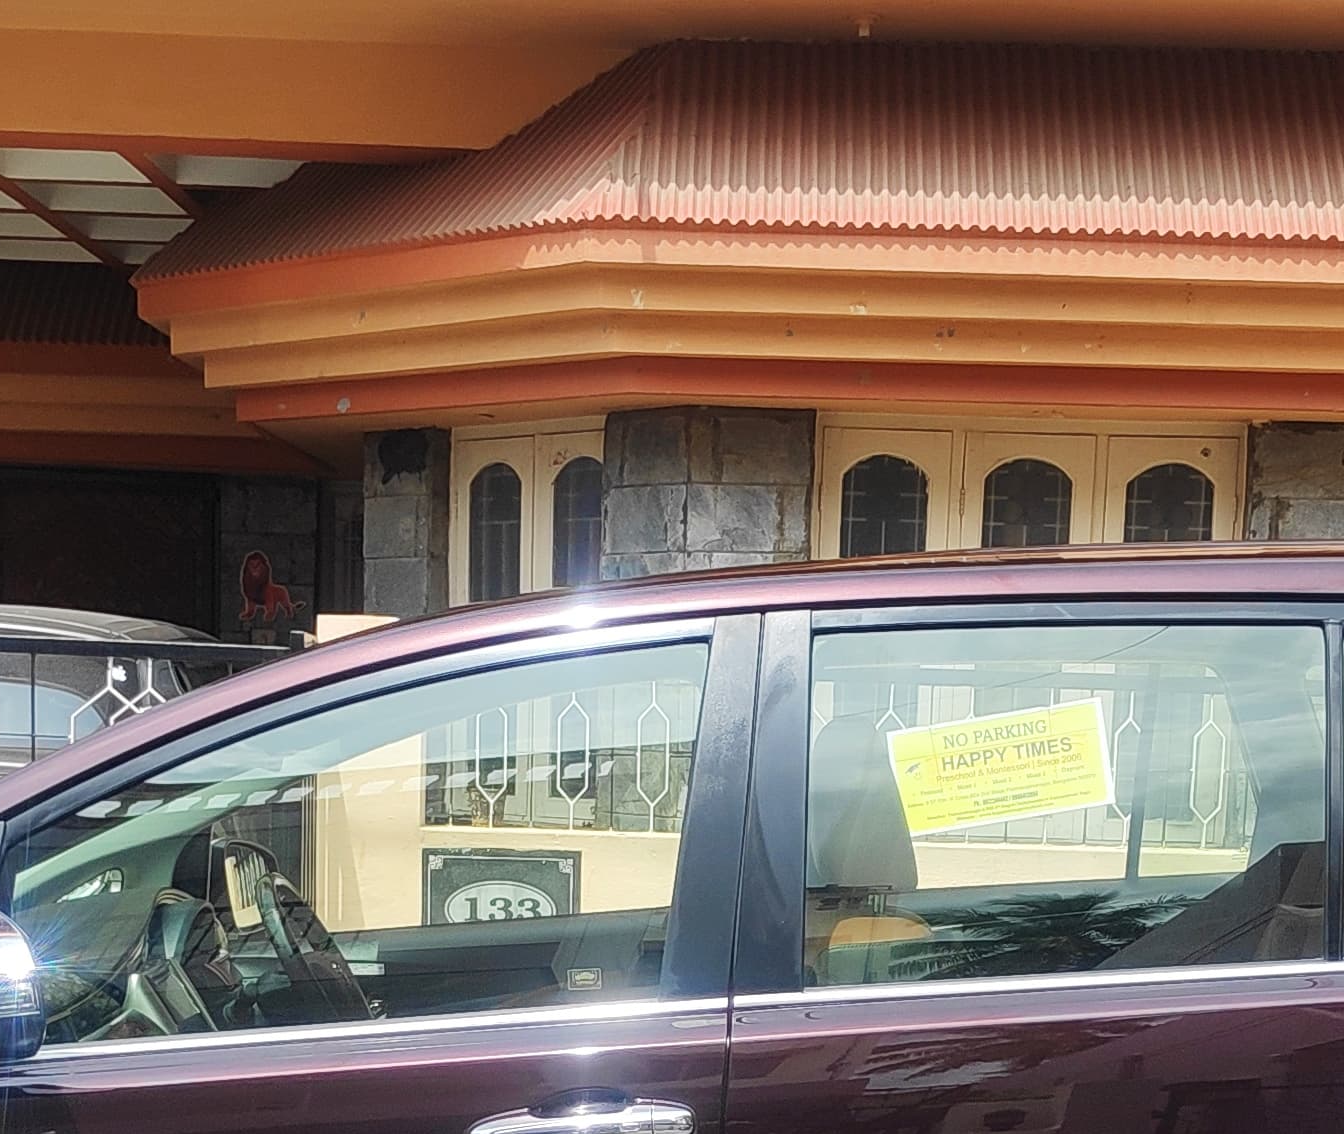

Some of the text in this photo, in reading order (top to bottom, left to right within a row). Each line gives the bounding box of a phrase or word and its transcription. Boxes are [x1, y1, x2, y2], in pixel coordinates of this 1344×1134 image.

[942, 719, 1047, 750] NO PARKING
[941, 736, 1073, 772] HAPPY TIMES
[986, 760, 1031, 776] Montessori
[464, 897, 542, 921] 133
